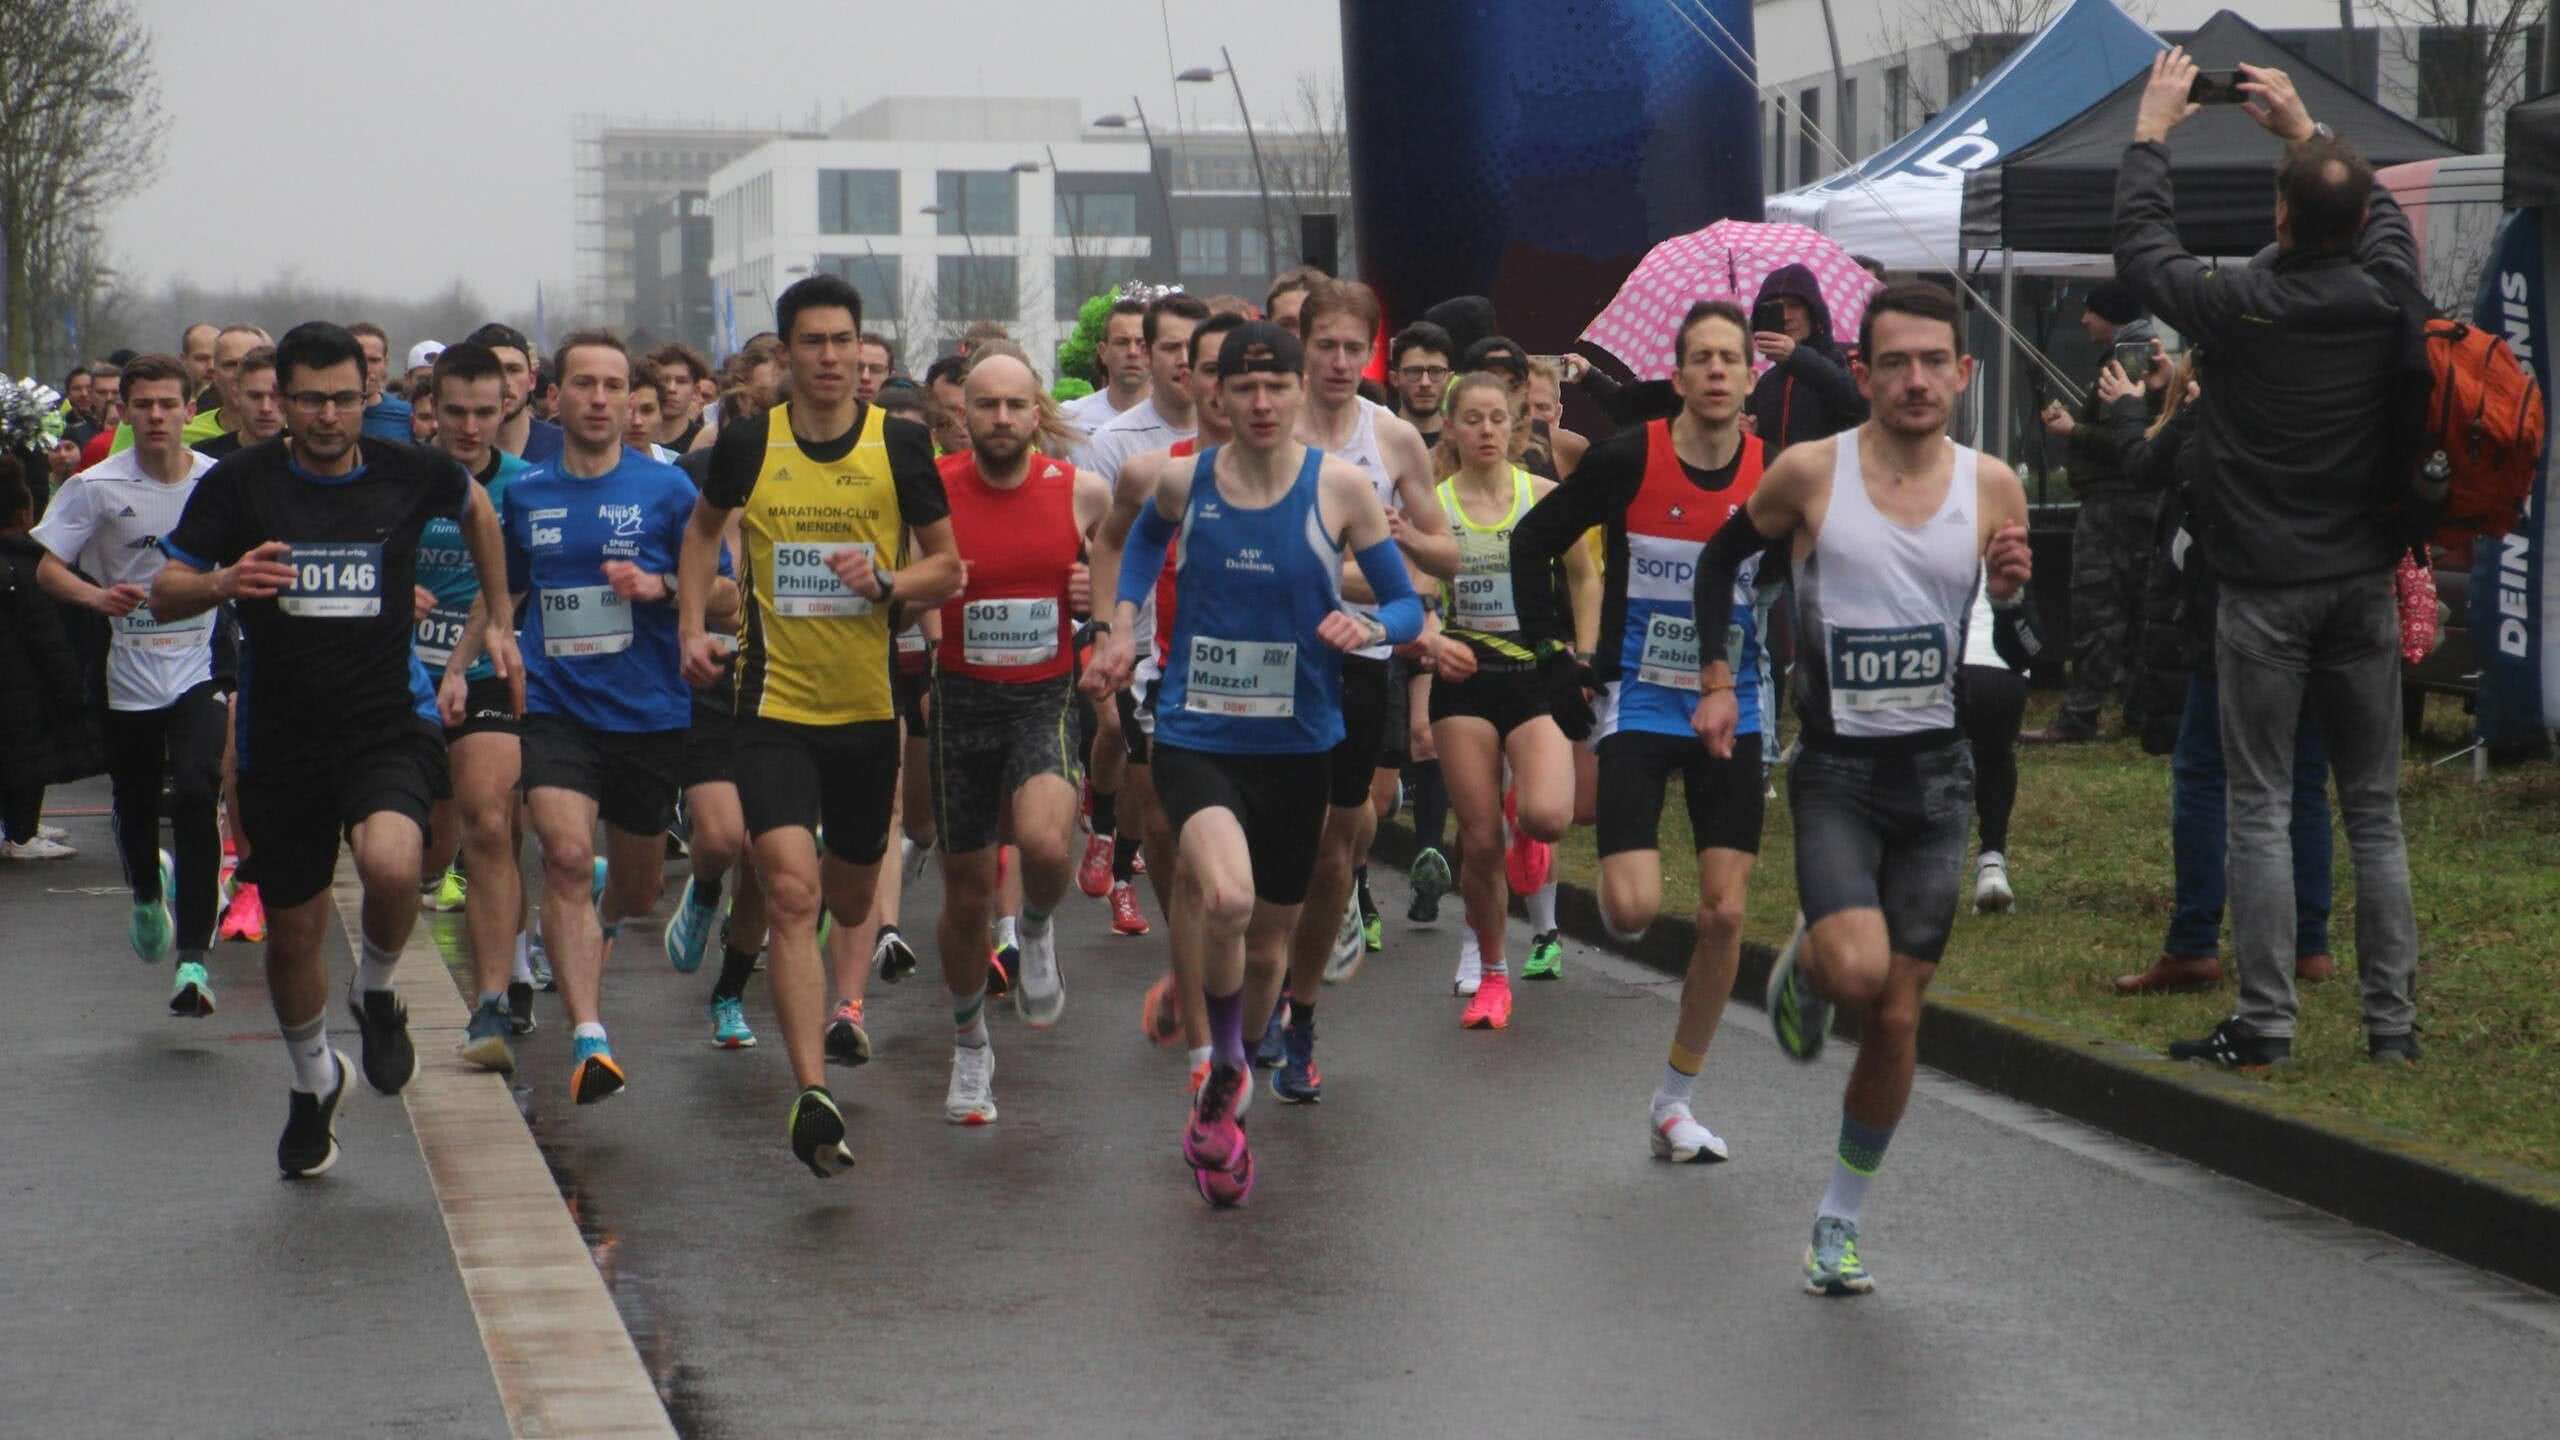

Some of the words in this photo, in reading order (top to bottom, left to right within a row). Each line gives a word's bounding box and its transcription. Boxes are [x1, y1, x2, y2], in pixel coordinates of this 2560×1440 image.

[767, 506, 880, 520] MARATHON-CLUB
[795, 521, 852, 533] MENDEN
[777, 549, 822, 568] 506
[1238, 548, 1264, 560] ASV
[289, 563, 377, 592] 10146
[777, 574, 841, 592] Philipp
[1458, 579, 1494, 594] 509
[543, 594, 580, 612] 788
[2498, 533, 2531, 659] DEIN
[967, 605, 1009, 621] 503
[417, 619, 464, 647] 013
[967, 628, 1039, 642] Leonard
[1652, 620, 1697, 643] 699
[1194, 643, 1238, 666] 501
[1647, 645, 1698, 665] Fabie
[1840, 647, 1941, 683] 10129
[1192, 669, 1259, 689] Mazzel
